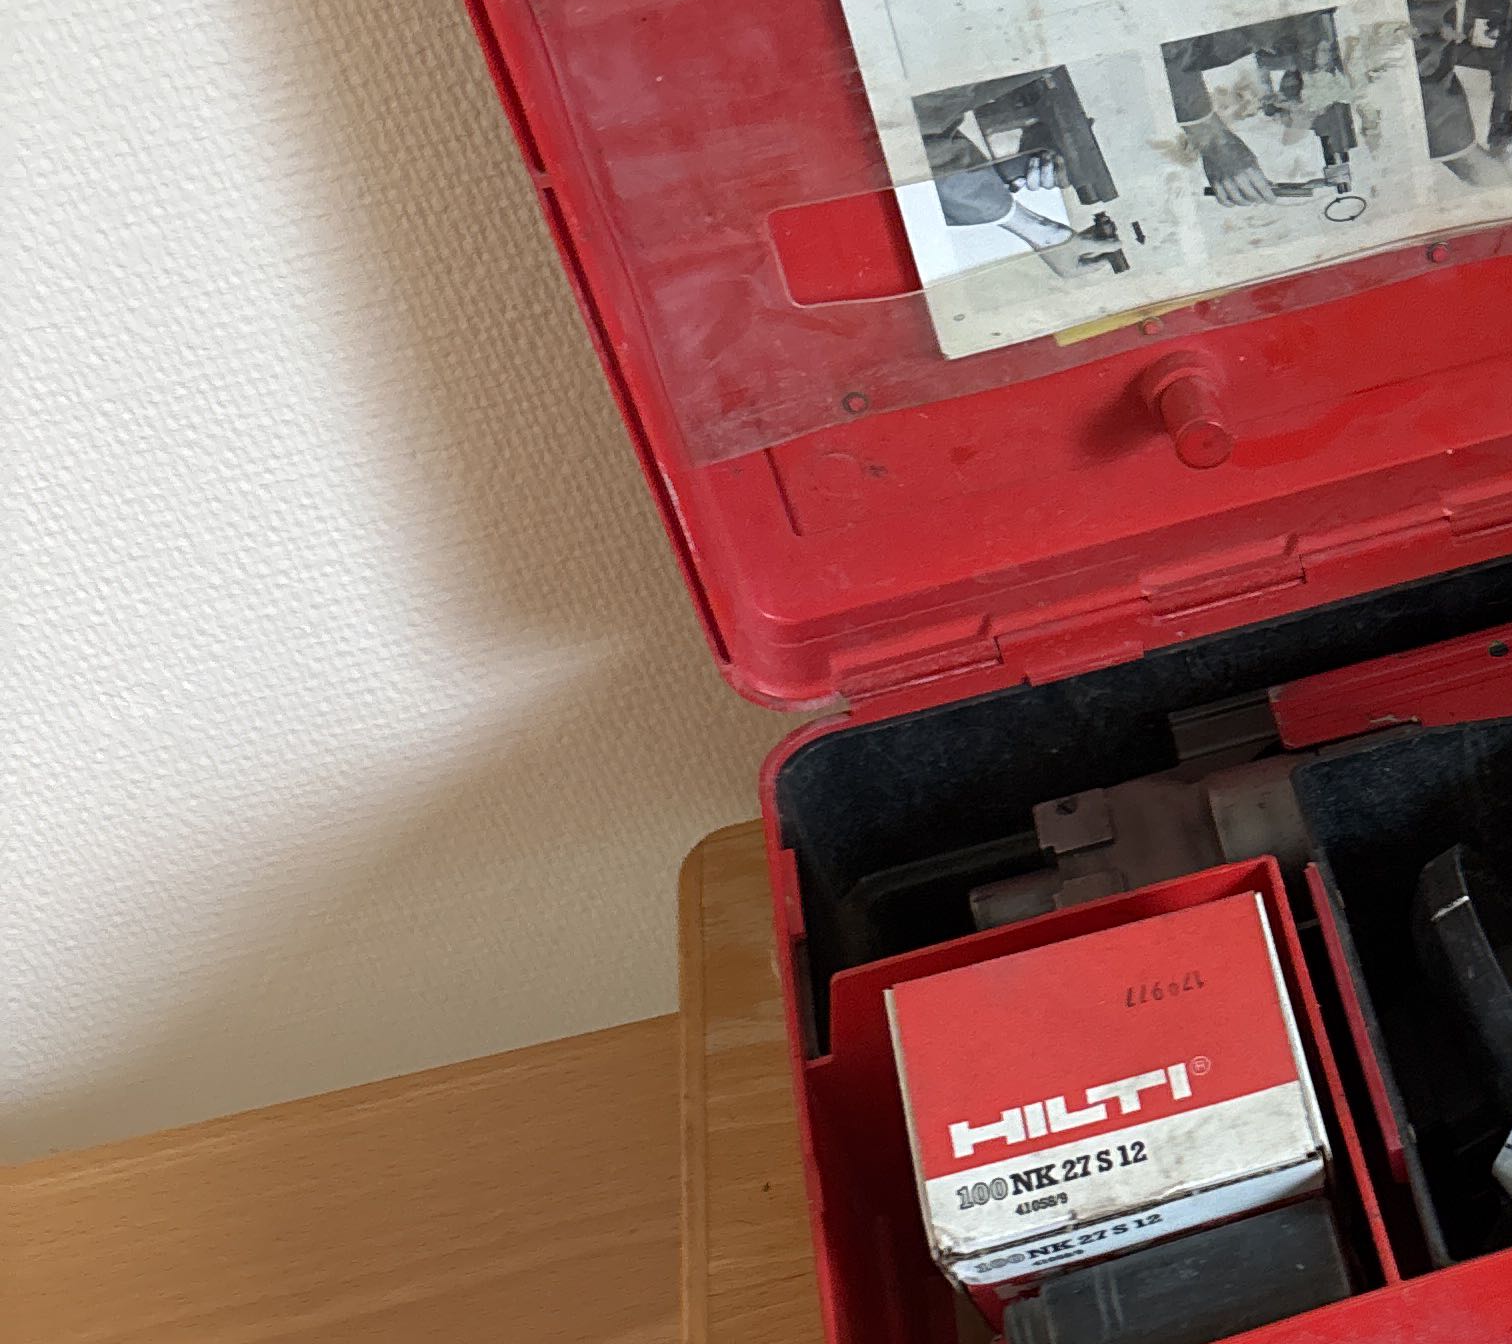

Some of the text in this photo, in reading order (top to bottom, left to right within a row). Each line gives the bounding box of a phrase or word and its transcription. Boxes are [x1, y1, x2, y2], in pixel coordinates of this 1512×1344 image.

[949, 1062, 1193, 1158] HILTI
[956, 1141, 1148, 1211] 100 NK 27 S 12
[1026, 1238, 1076, 1261] NK
[1076, 1228, 1109, 1248] 27
[1111, 1222, 1131, 1237] S
[1133, 1213, 1163, 1231] 12
